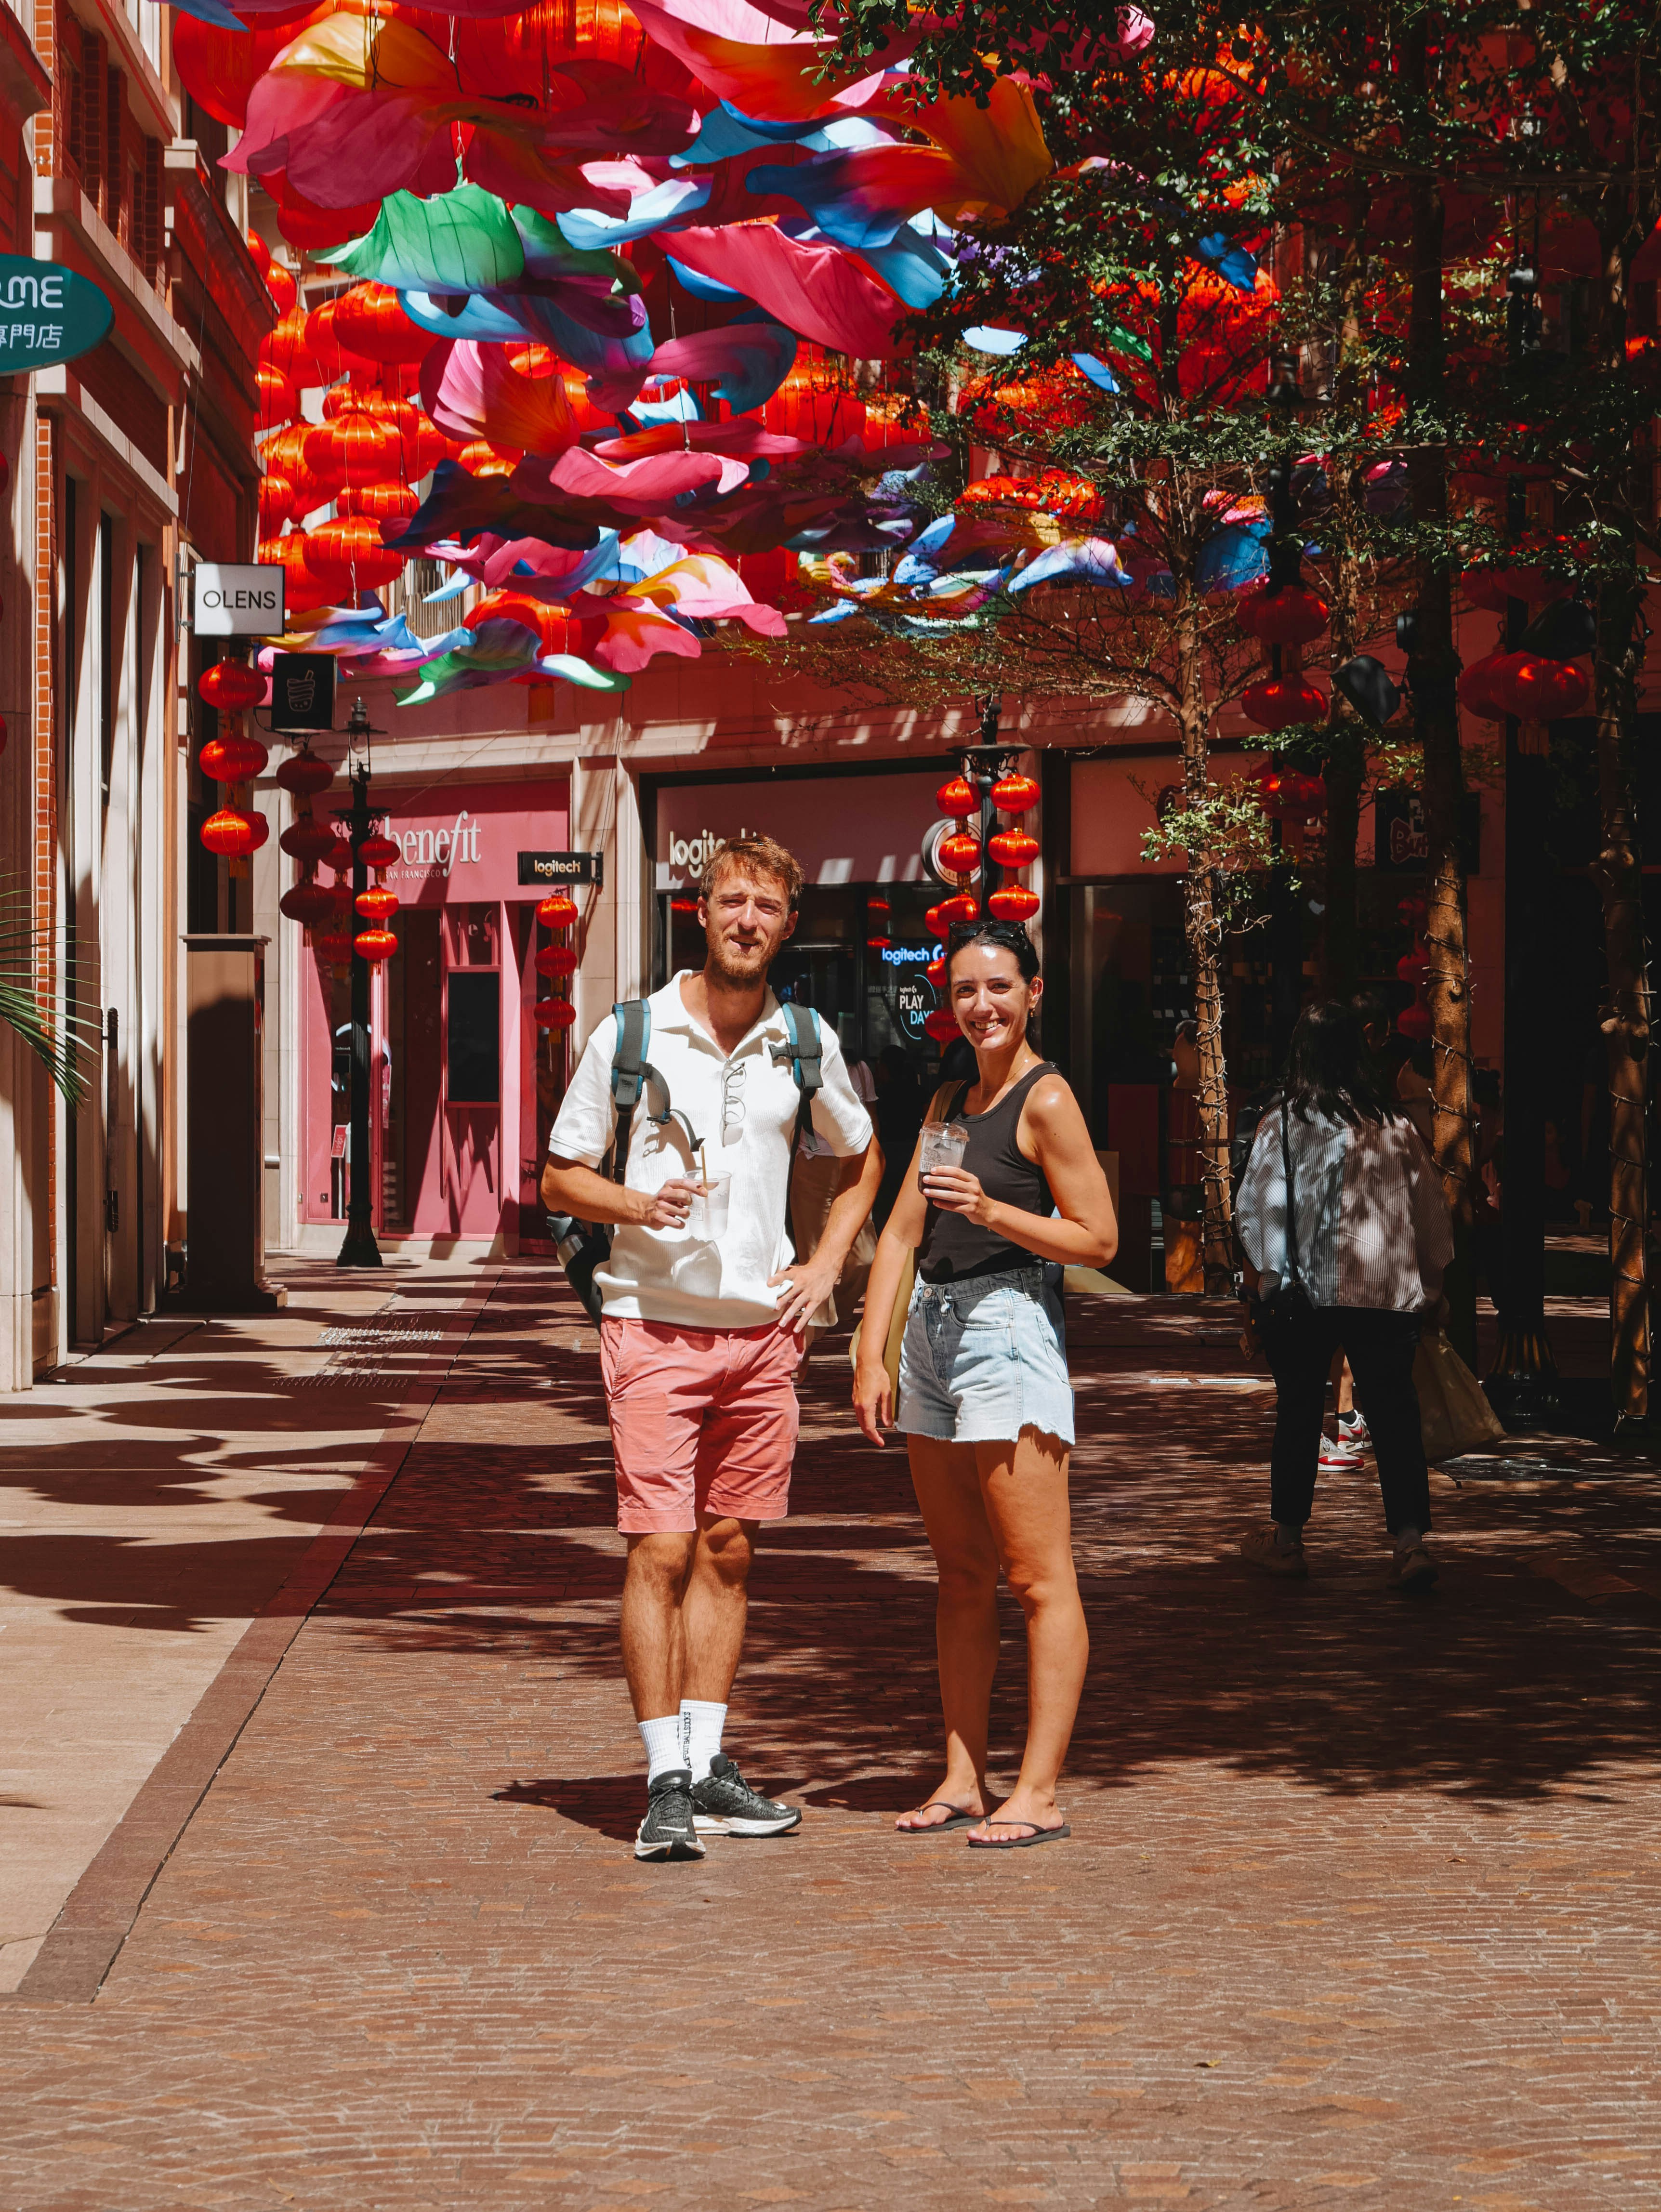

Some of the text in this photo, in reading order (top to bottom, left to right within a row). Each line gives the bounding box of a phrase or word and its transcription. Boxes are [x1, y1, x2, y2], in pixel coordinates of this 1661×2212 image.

[203, 590, 276, 609] OLENS
[401, 869, 440, 880] FRANCISCO
[534, 859, 581, 877] logitech
[882, 947, 929, 966] logitech
[899, 995, 924, 1010] PLAY
[910, 1010, 935, 1025] DAY
